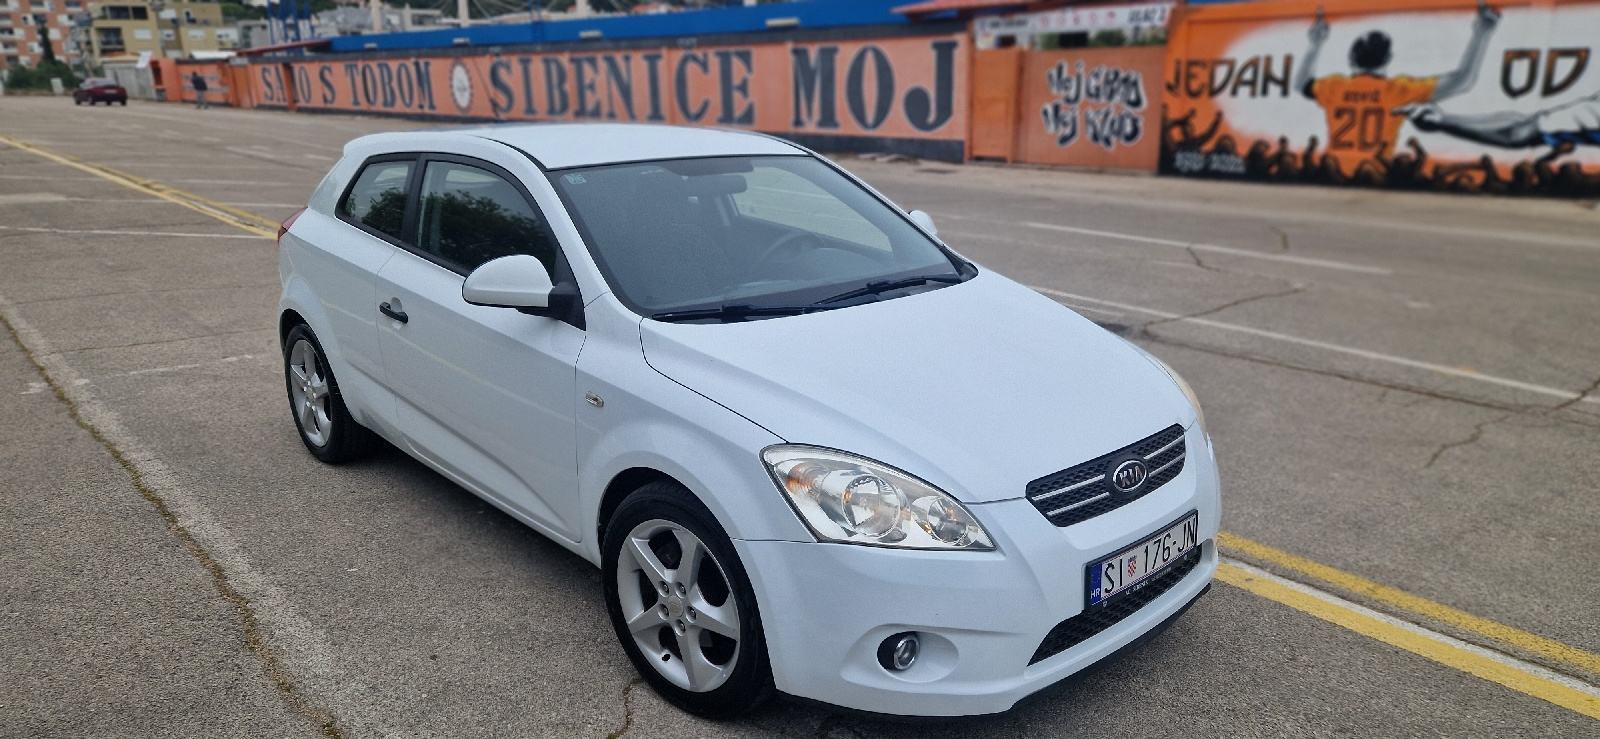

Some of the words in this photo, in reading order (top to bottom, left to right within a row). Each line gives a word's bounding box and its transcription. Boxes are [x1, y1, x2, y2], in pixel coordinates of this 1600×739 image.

[319, 64, 336, 104] S
[345, 60, 436, 110] TOBOM
[792, 40, 959, 132] MOJ
[1165, 54, 1293, 98] JEDAN
[1501, 48, 1591, 98] OD
[1333, 106, 1385, 151] 20
[1118, 465, 1143, 487] KIA
[1144, 517, 1197, 573] 176-JN
[1090, 587, 1101, 599] HR
